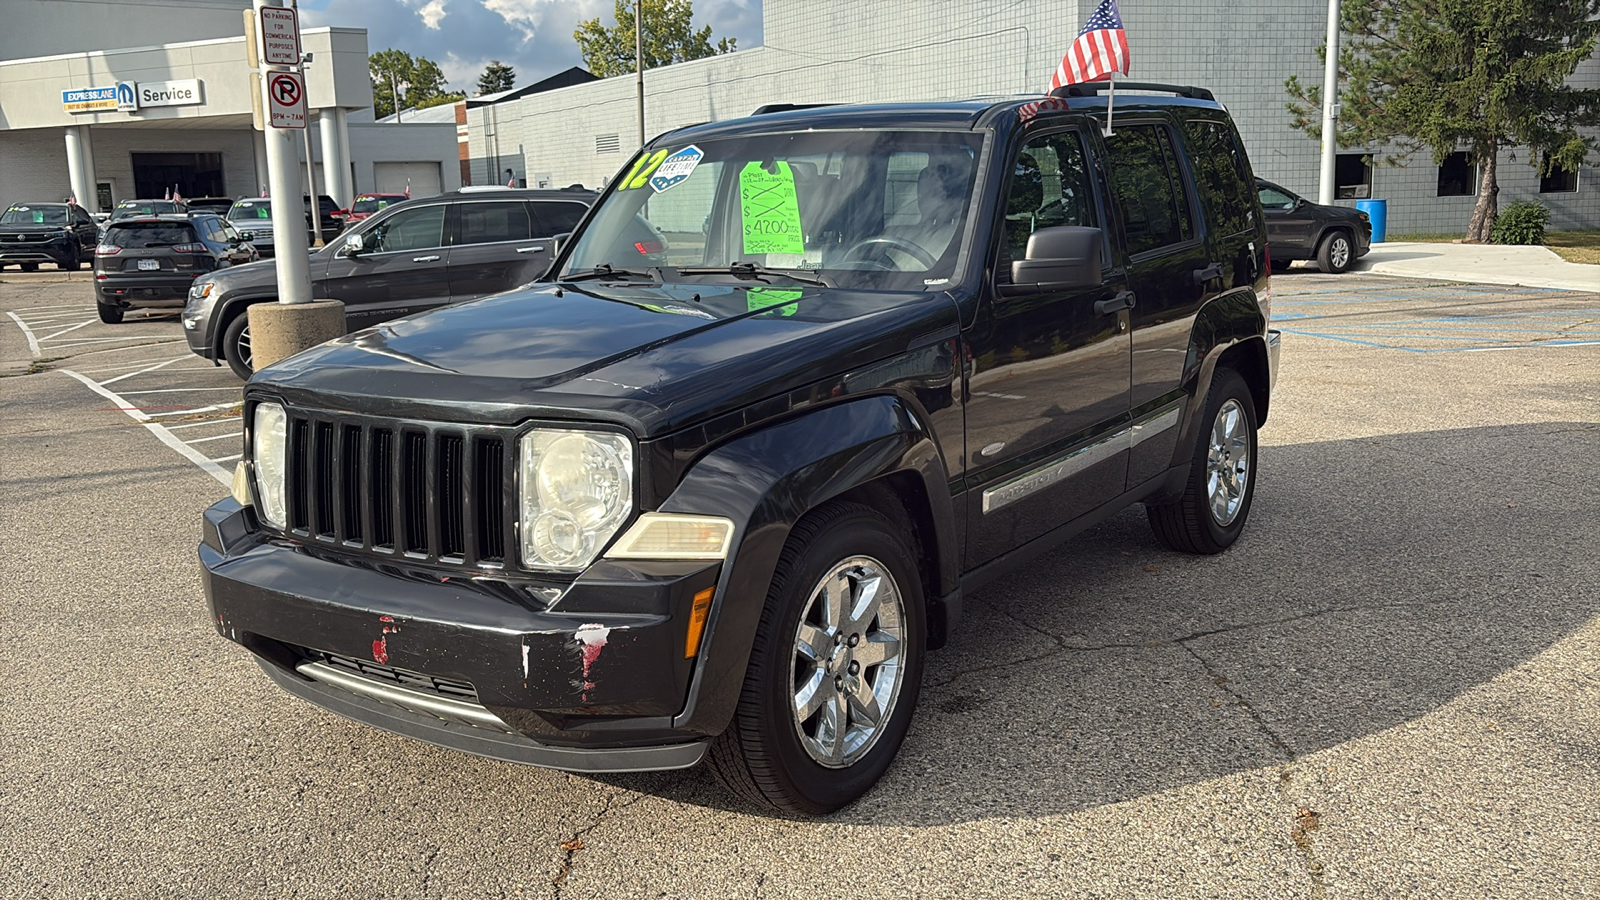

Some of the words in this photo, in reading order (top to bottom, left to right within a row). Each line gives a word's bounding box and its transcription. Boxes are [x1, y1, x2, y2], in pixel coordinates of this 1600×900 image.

[143, 88, 192, 102] Service
[272, 112, 285, 120] 8PM
[618, 148, 669, 191] 12
[658, 162, 697, 173] LIFETIME
